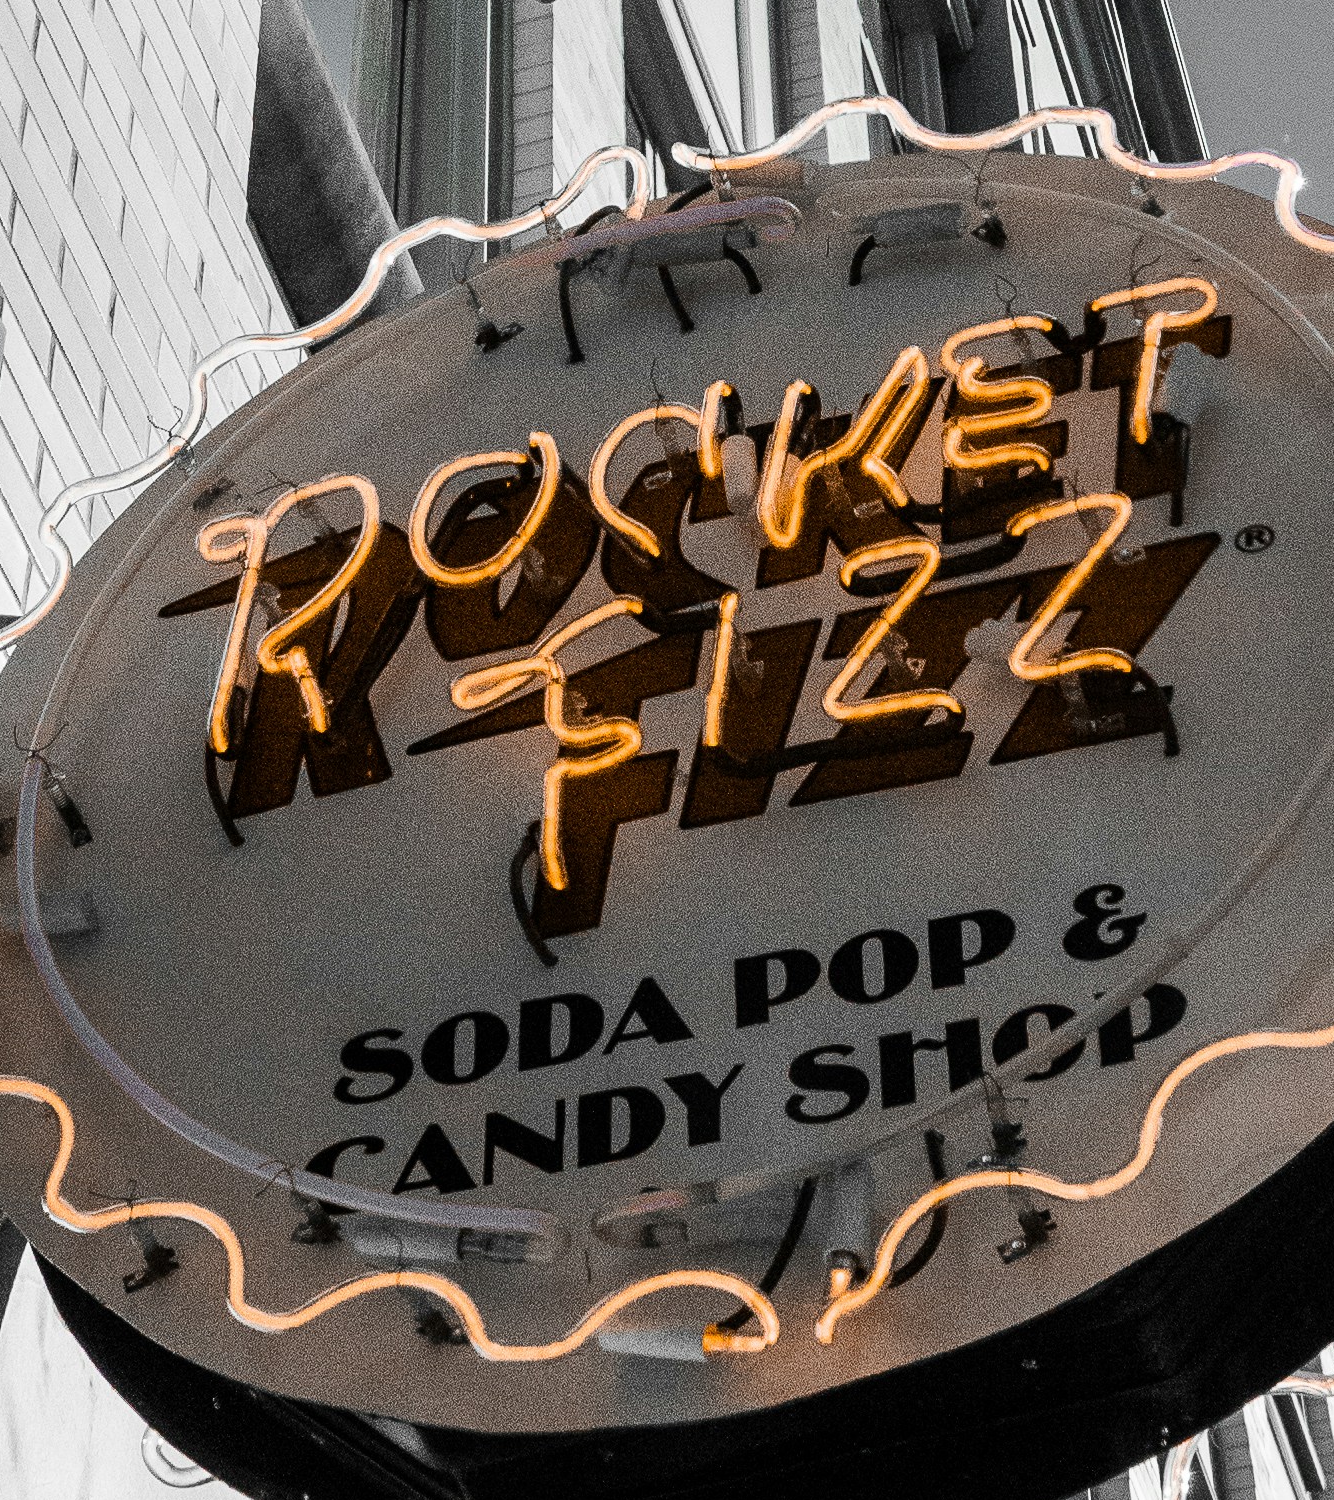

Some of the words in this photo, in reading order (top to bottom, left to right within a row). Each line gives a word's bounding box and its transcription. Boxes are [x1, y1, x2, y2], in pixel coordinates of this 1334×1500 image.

[159, 276, 1231, 817] ROCKET
[406, 492, 1221, 939] FIZZ
[304, 1063, 745, 1215] CANDY
[784, 981, 1189, 1124] SHOP
[333, 976, 693, 1105] SODA
[733, 908, 1016, 1030] POP
[1062, 883, 1148, 962] &
